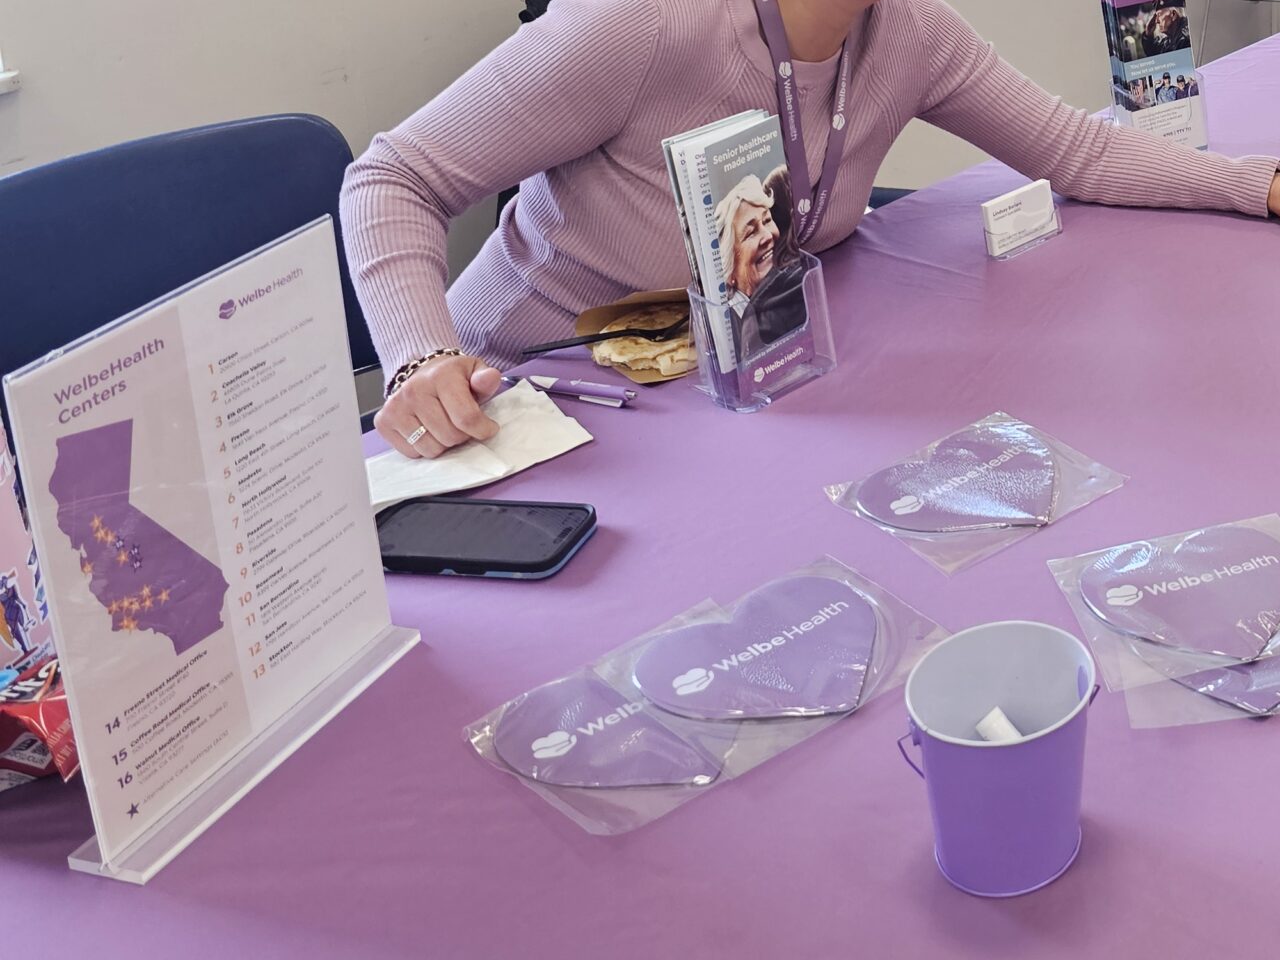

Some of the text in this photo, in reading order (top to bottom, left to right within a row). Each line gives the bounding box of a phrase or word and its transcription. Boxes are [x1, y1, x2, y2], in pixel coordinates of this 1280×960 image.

[712, 129, 778, 165] Senior healthcare
[723, 157, 746, 173] made
[746, 144, 771, 164] simple
[238, 266, 304, 309] WelbeHealth
[53, 338, 165, 405] WelbeHealth
[208, 352, 238, 375] 1 Carson
[763, 347, 804, 374] WelbeHealth
[57, 378, 127, 425] Centers
[211, 360, 266, 403] 2 Coachella Valley
[215, 401, 253, 428] 3 Elk Grove
[220, 429, 250, 453] 4 Fresno
[224, 443, 266, 479] 5 Long Beach
[228, 468, 262, 504] 6 Modesto
[921, 443, 1029, 500] WelbeHealth
[233, 476, 286, 529] 7 North Hollywood
[236, 518, 272, 554] 8 Pasadena
[240, 548, 276, 580] 9 Riverside
[1144, 553, 1280, 597] WelbeHealth
[239, 567, 283, 607] 10 Rosemead
[245, 579, 299, 627] 11 San Bernardino
[249, 621, 287, 657] 12 San Jose
[712, 600, 849, 672] WelbeHealth
[253, 641, 292, 679] 13 Stockton
[105, 650, 207, 734] 14 Fresno Street Medical Office
[112, 682, 210, 766] 15 Coffee Road Medical Office
[117, 716, 200, 789] 16 Walnut Medical Office
